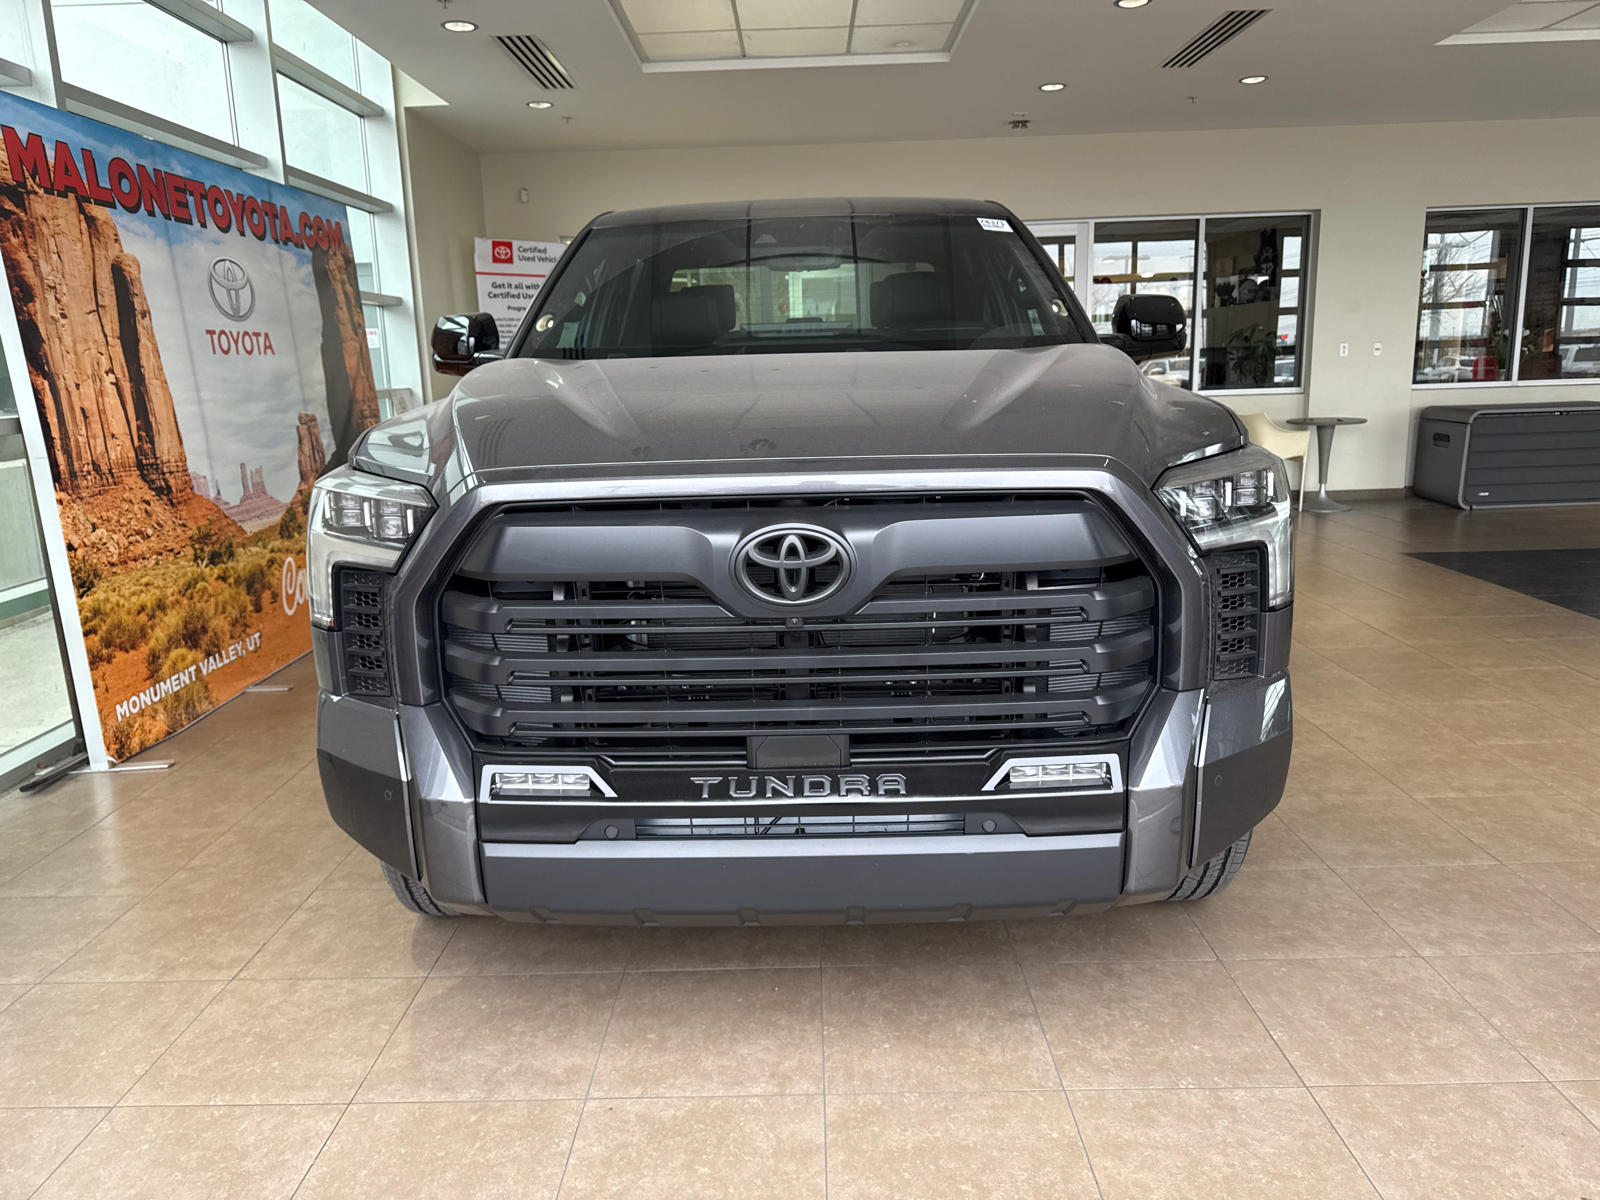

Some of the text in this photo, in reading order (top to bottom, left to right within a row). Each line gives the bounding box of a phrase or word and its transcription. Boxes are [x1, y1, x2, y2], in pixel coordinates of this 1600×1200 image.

[1, 124, 346, 253] MALONETOYOTA.COM
[517, 245, 547, 254] Certified
[518, 254, 557, 263] Used Vehicl
[487, 291, 521, 299] Certified
[491, 281, 506, 289] Get
[506, 281, 513, 289] it
[514, 282, 524, 290] all
[205, 329, 276, 356] TOYOTA
[282, 556, 309, 616] Co
[115, 632, 261, 722] MONUMENT VALLEY, UT
[690, 773, 907, 799] TUNDRA
